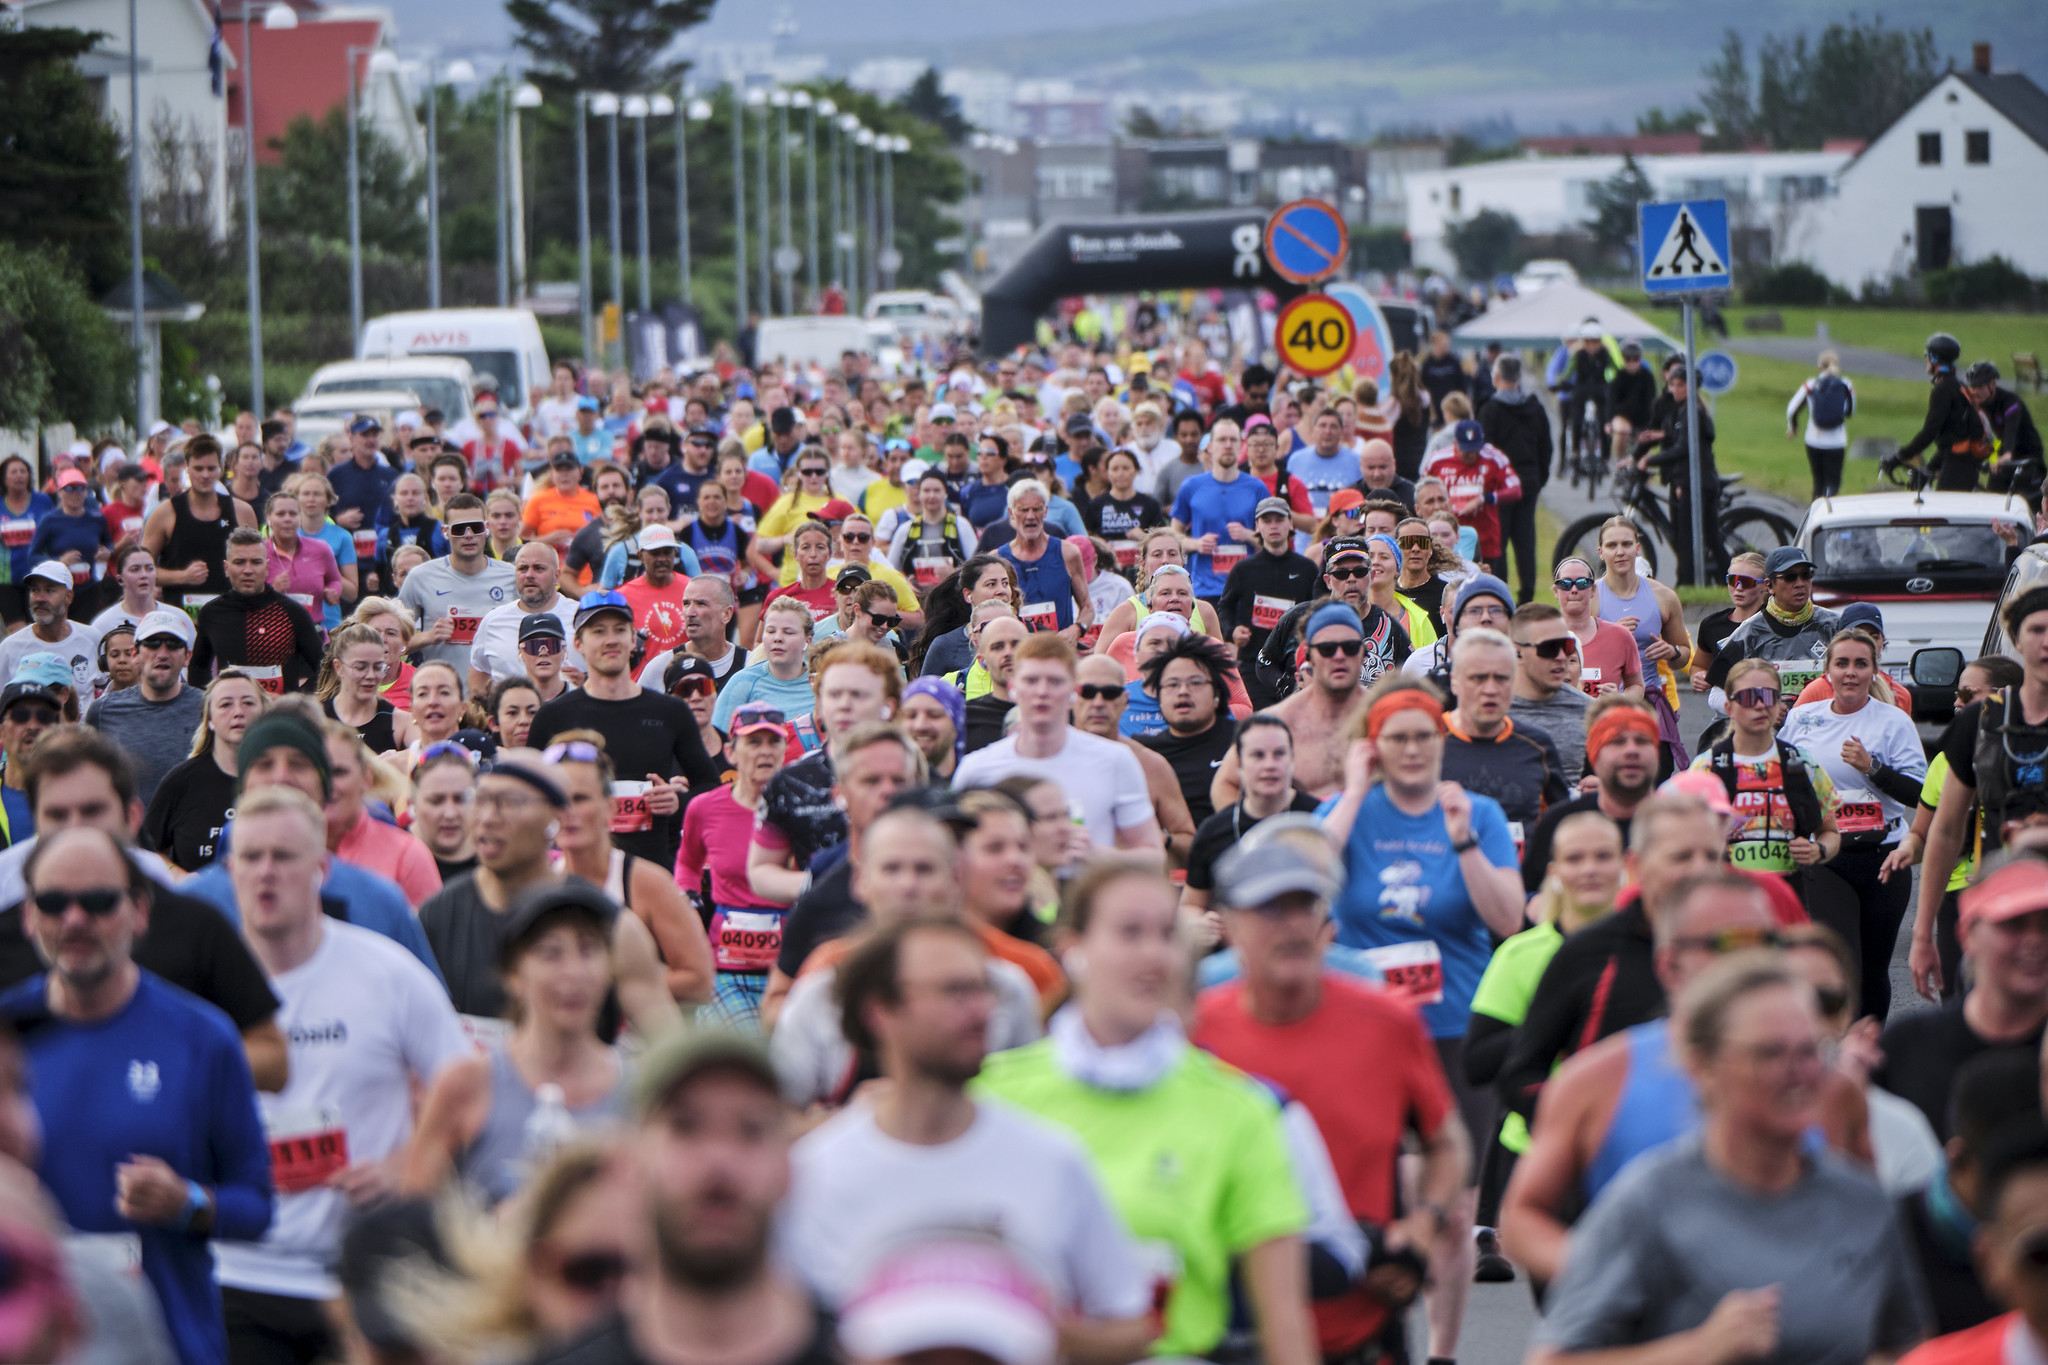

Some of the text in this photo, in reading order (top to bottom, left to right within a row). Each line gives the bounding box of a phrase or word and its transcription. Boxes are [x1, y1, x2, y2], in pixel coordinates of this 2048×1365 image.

[411, 331, 469, 346] AVIS
[1288, 318, 1345, 352] 40
[199, 845, 213, 857] IS
[1735, 844, 1790, 862] 01042
[722, 931, 780, 949] 04090
